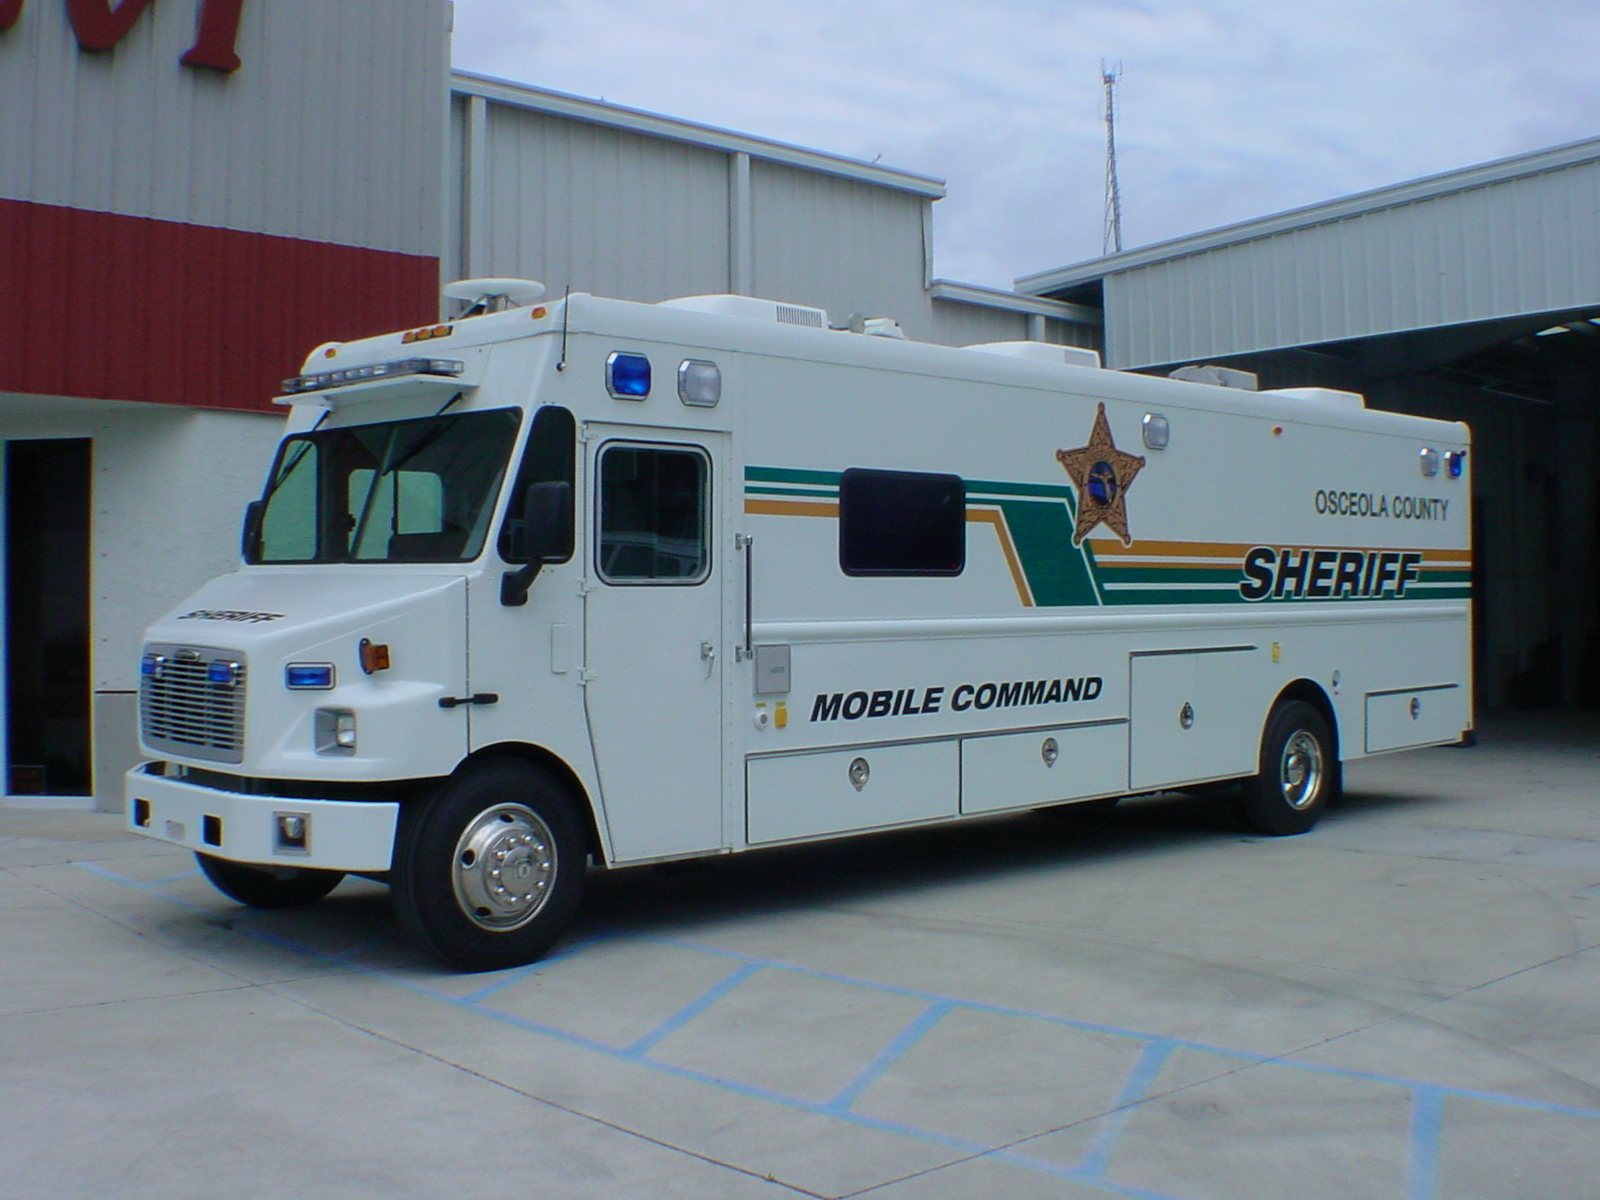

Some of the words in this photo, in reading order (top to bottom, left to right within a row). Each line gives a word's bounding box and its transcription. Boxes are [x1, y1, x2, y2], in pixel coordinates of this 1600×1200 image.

[1315, 489, 1389, 518] OSCEOLA
[1393, 496, 1449, 520] COUNTY
[1239, 546, 1422, 601] SHERIFF
[177, 609, 286, 624] SHERIFF
[810, 686, 945, 722] MOBILE
[951, 676, 1103, 712] COMMAND
